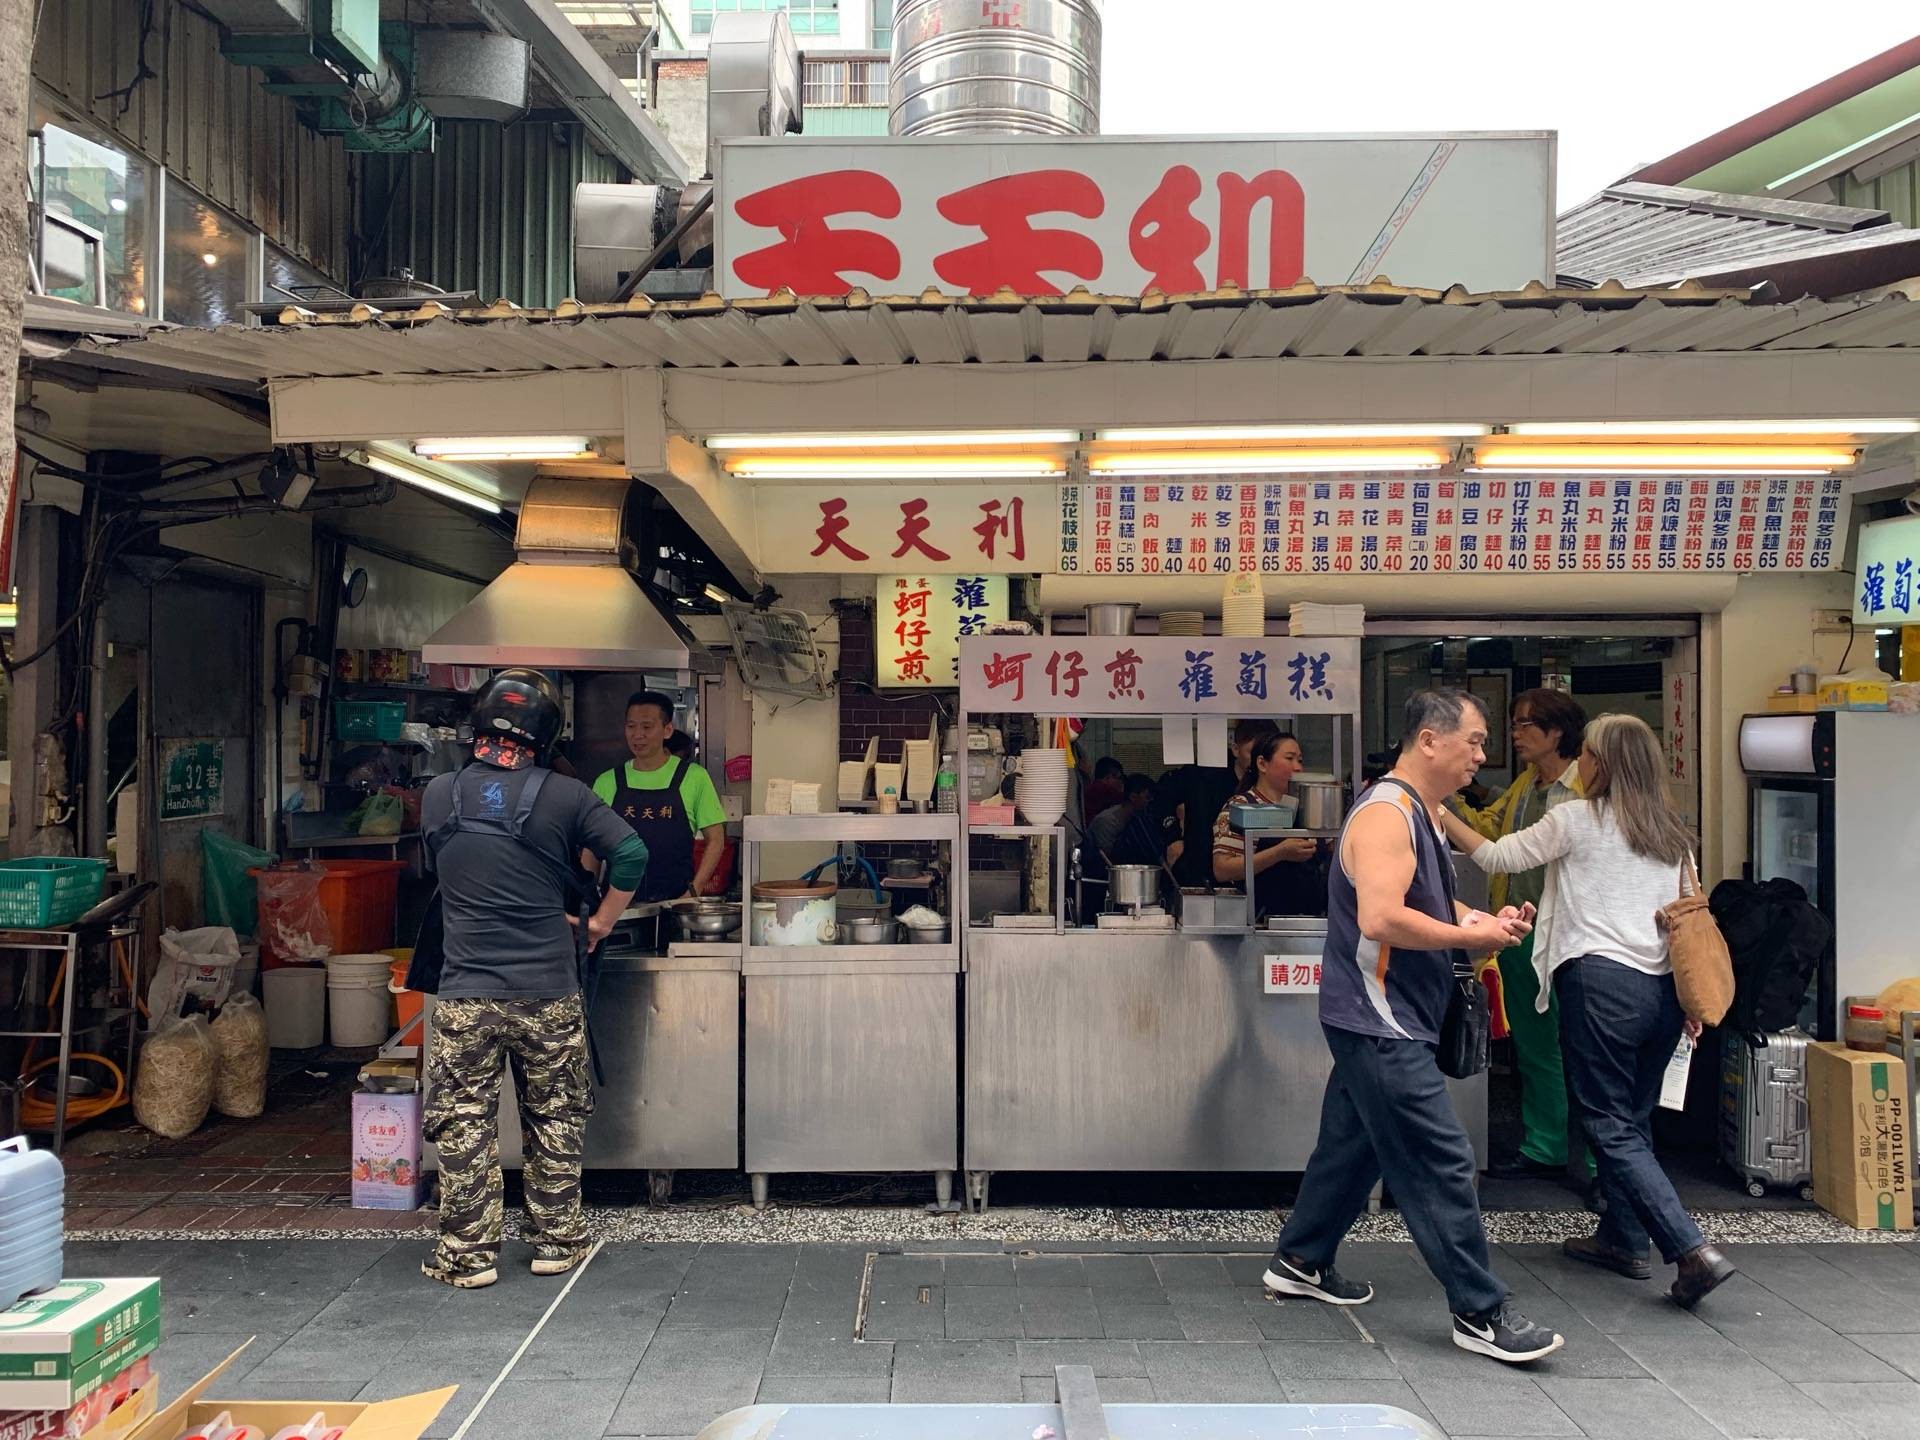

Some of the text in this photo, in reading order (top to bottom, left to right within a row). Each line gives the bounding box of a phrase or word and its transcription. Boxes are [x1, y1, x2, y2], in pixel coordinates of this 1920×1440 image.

[810, 497, 1026, 562] 天天利
[1188, 485, 1208, 573] 乾米粉 40
[1213, 485, 1232, 572] 乾冬粉 40
[1312, 483, 1331, 571] 貢丸湯 35
[1334, 483, 1355, 571] 青菜湯 40
[1360, 483, 1380, 571] 蛋花湯 30
[1459, 482, 1481, 570] 油豆腐 30
[1508, 481, 1531, 570] 切仔米粉 40
[1533, 481, 1556, 570] 魚丸麵 55
[1558, 481, 1581, 570] 魚丸米粉 55
[1606, 481, 1632, 569] 貢丸米粉 55
[1061, 556, 1077, 571] 65
[1094, 556, 1112, 573] 65
[1117, 556, 1134, 573] 55
[1141, 556, 1159, 573] 30
[1165, 556, 1182, 573] 40
[1239, 556, 1257, 572] 55
[1262, 556, 1280, 571] 65
[1285, 556, 1302, 572] 35
[1384, 555, 1402, 571] 40
[1409, 555, 1428, 571] 20
[1433, 554, 1451, 570] 30
[1484, 554, 1503, 570] 40
[1582, 554, 1601, 570] 55
[1632, 553, 1651, 570] 55
[1658, 553, 1676, 569] 55
[1682, 553, 1701, 569] 55
[1706, 553, 1725, 569] 55
[1733, 553, 1752, 569] 65
[1759, 552, 1778, 568] 65
[1785, 552, 1804, 568] 65
[1810, 552, 1829, 568] 65
[1861, 558, 1920, 616] 蘿蔔
[893, 590, 932, 683] 蚵仔煎
[982, 648, 1335, 702] 蚵仔煎 蘿蔔糕
[624, 805, 673, 820] 天天利
[1890, 1098, 1905, 1194] PP-001LWR1
